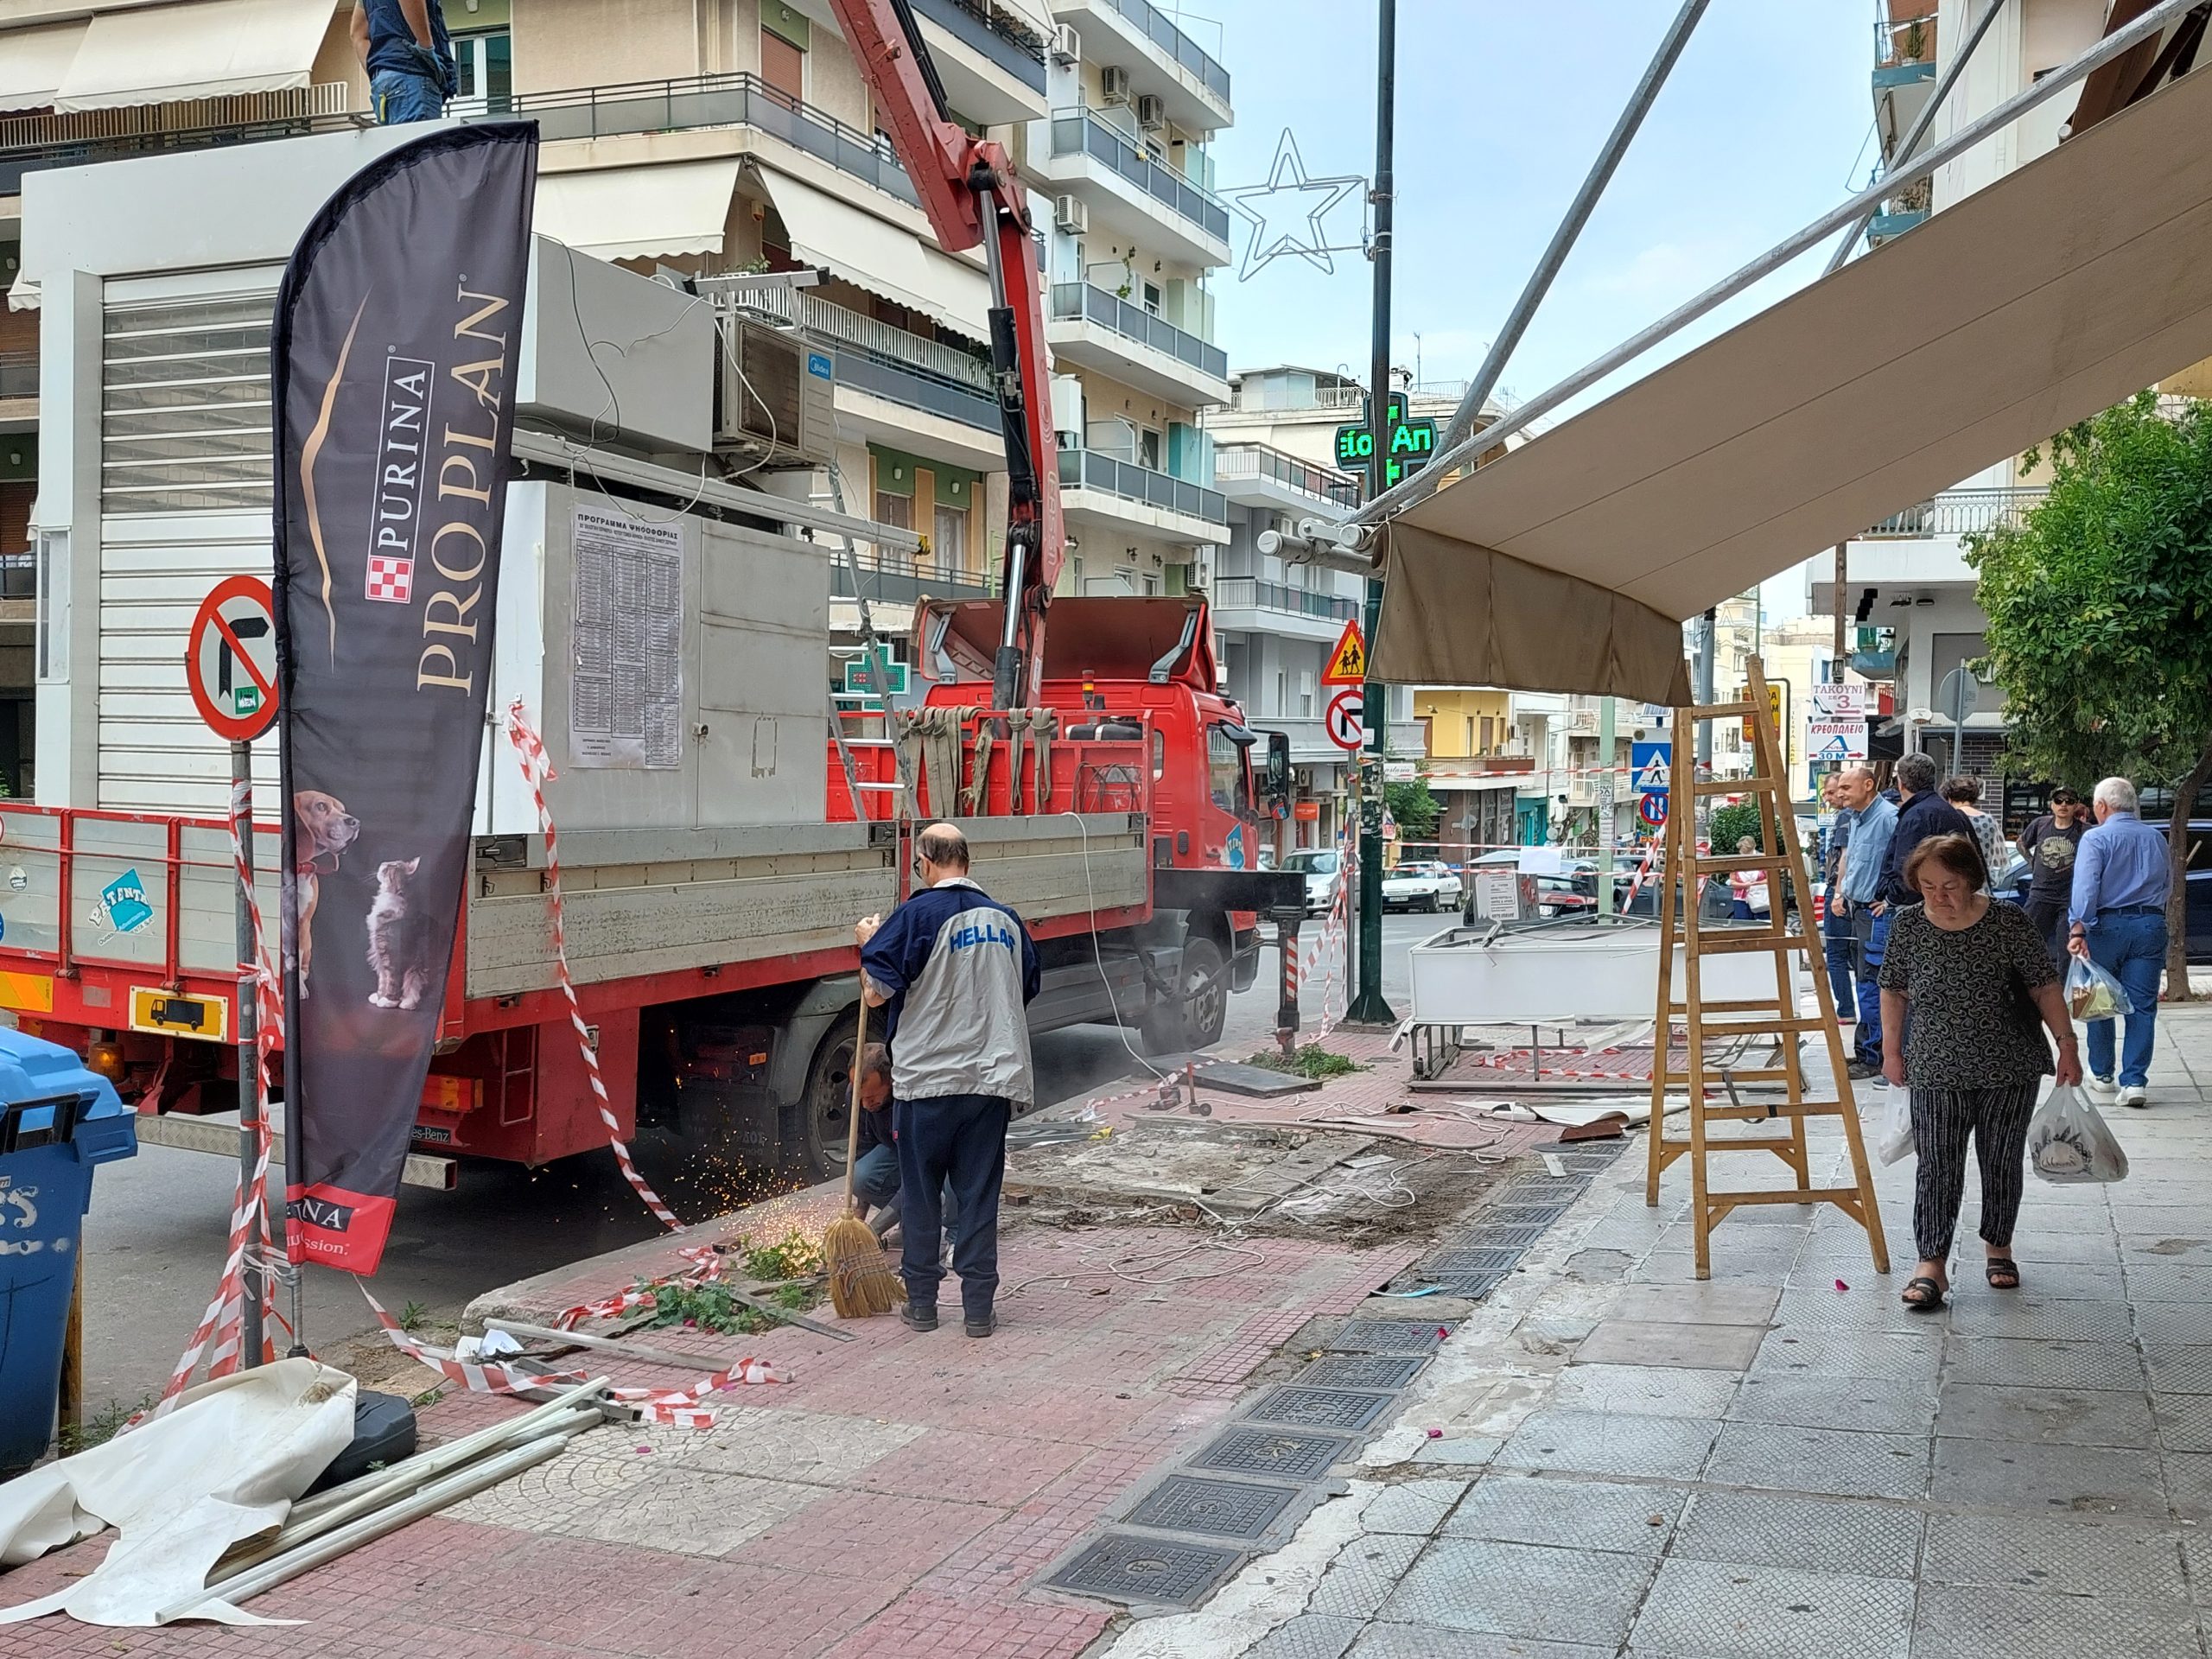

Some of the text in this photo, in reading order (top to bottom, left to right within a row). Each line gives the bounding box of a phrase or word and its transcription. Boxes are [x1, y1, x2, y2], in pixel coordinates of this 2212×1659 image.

[377, 369, 426, 552] PURINA
[417, 282, 510, 697] PRO PLAN
[577, 513, 627, 531] ΠΡΟΓΡΑΜΜΑ
[1813, 685, 1863, 694] ΤΑΚΟΥΝΙ
[1837, 695, 1850, 709] 3
[1810, 724, 1864, 734] ΚΡΕΟΠΩΛΕΙΟ
[950, 924, 1015, 955] HELLAS
[412, 1127, 449, 1142] es-Benz
